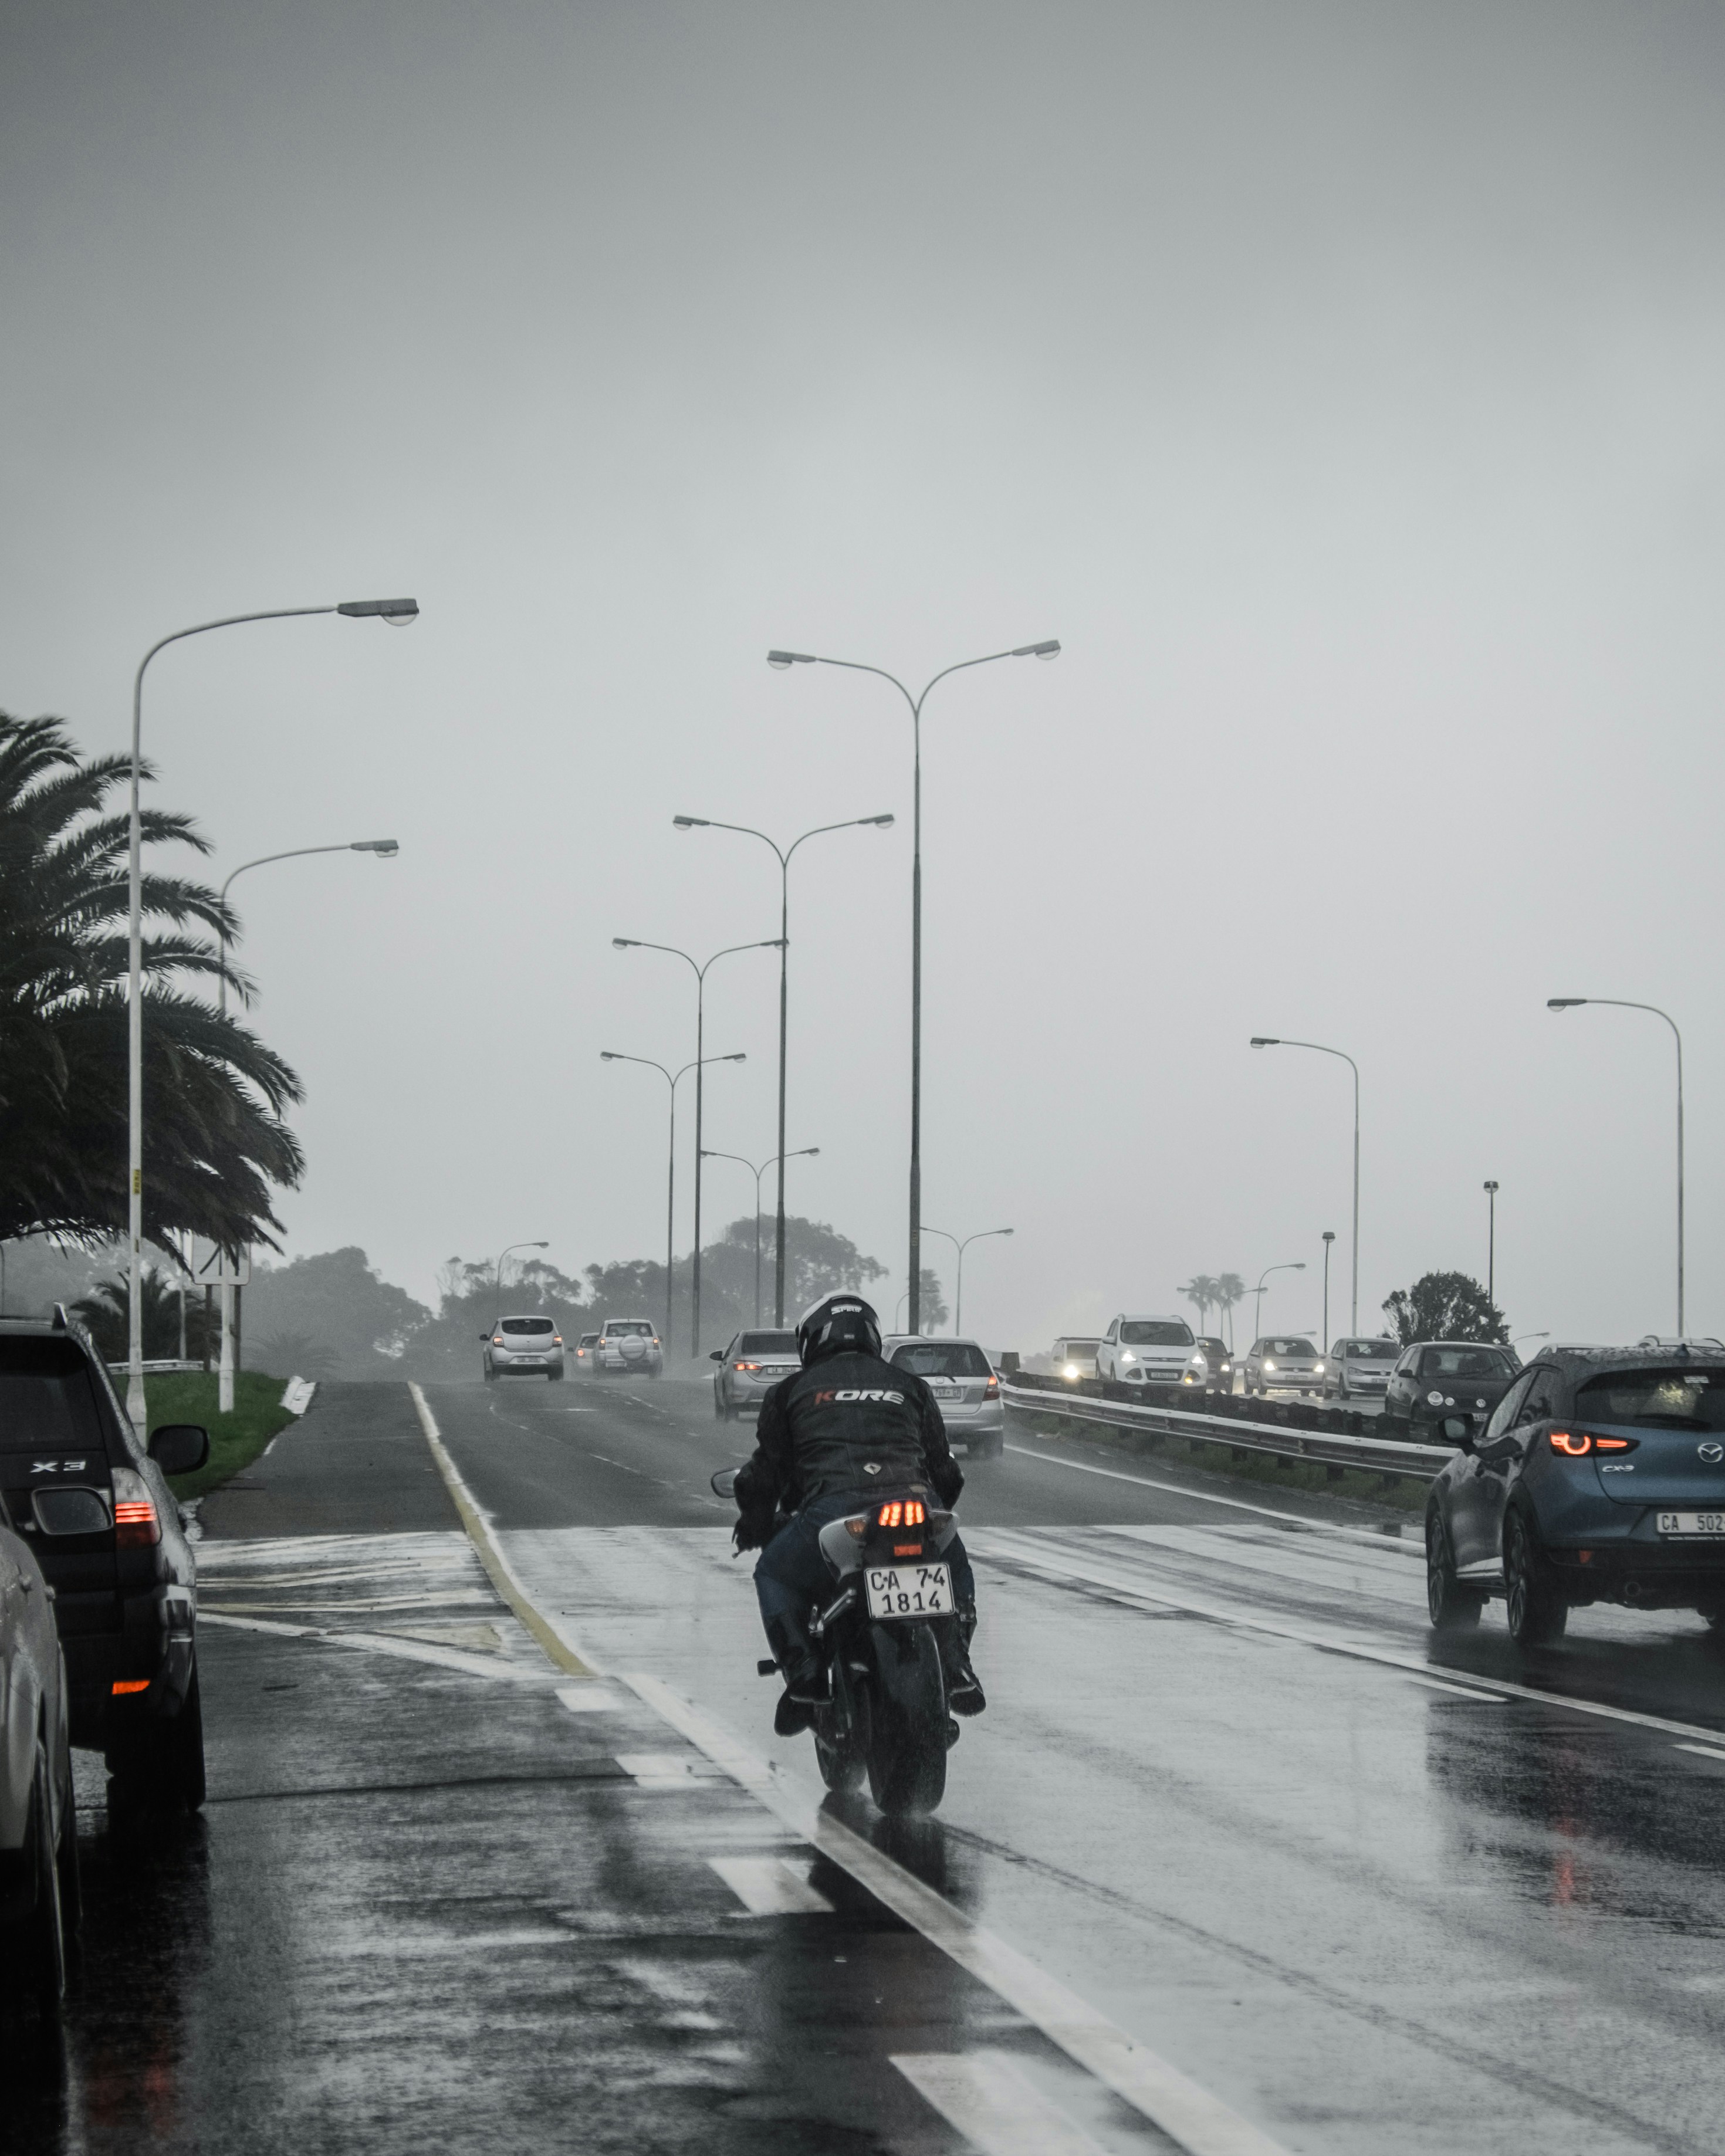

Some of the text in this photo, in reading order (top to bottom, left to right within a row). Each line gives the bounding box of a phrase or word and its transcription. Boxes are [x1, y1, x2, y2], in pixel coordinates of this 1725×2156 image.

[815, 1390, 905, 1405] KORE
[1662, 1515, 1679, 1531] CA
[882, 1590, 941, 1615] 1814
